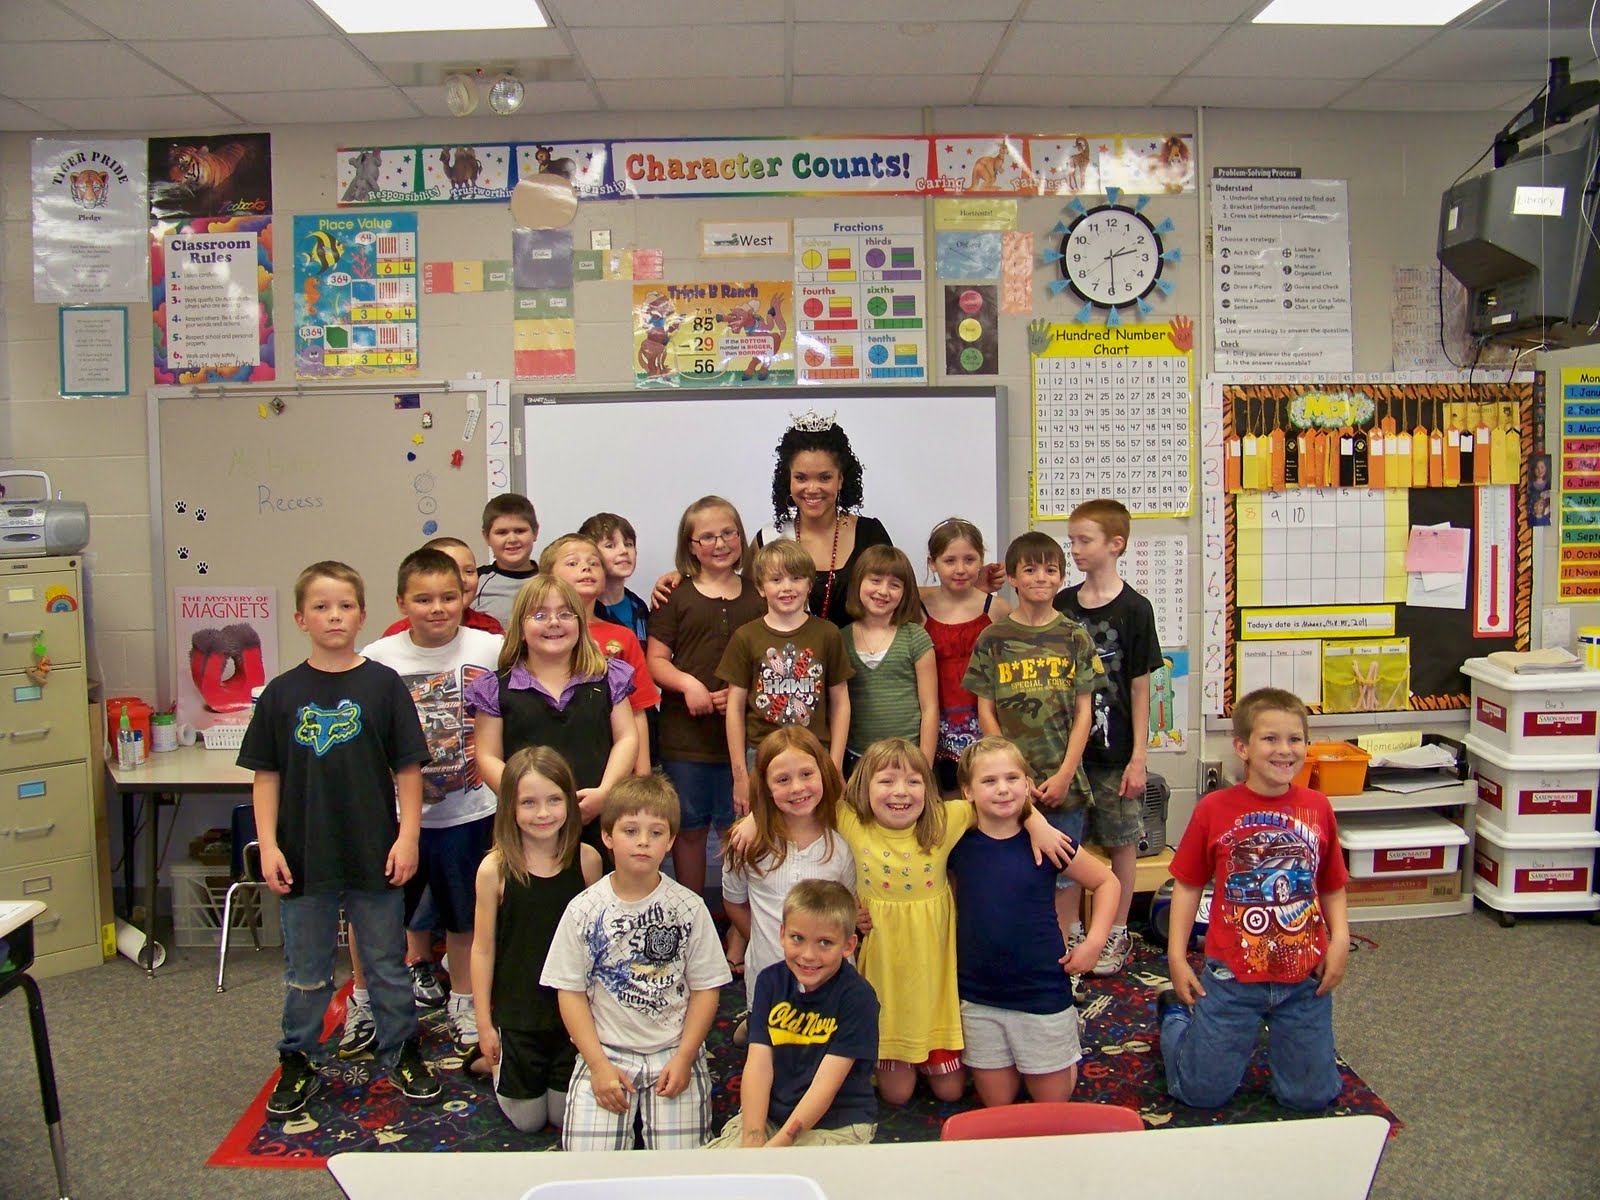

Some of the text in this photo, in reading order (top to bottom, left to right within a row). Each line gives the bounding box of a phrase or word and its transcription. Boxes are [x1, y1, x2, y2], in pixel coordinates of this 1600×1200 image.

[52, 151, 129, 185] TIGER PRIDE
[625, 152, 912, 181] Character Counts!
[1272, 168, 1297, 178] Process
[915, 175, 965, 191] Caring
[1215, 184, 1253, 192] Understand
[368, 185, 441, 201] Responsibility
[451, 186, 512, 198] Trustworthin
[319, 218, 393, 230] Place Value
[833, 222, 884, 232] Fractions
[1088, 224, 1130, 232] 11 1
[1105, 218, 1117, 227] 12
[1217, 224, 1232, 232] Plan
[360, 233, 372, 242] 64
[740, 235, 773, 246] West
[865, 237, 892, 246] thirds
[1075, 236, 1145, 244] 10 2
[171, 240, 251, 251] Classroom
[189, 252, 232, 264] Rules
[1073, 253, 1149, 262] 9 3
[331, 275, 348, 284] 364
[1078, 270, 1144, 278] 8 4
[667, 284, 758, 302] Triple B Ranch
[802, 286, 894, 295] fourths sixths
[1092, 283, 1133, 296] 7 6 5
[361, 309, 411, 319] 3 6 4
[693, 316, 714, 332] 85
[1219, 316, 1237, 325] Solve
[232, 333, 253, 341] personal
[300, 328, 322, 337] 1,364
[1056, 329, 1110, 341] Hundred
[1116, 329, 1166, 341] Number
[694, 337, 714, 352] 29
[868, 335, 897, 343] tenths
[1220, 340, 1240, 348] Check
[1093, 344, 1129, 355] Chart
[694, 359, 715, 374] 56
[1100, 392, 1110, 400] 25
[1162, 392, 1170, 400] 29
[1176, 392, 1186, 400] 30
[489, 421, 508, 446] 2
[1204, 421, 1223, 447] 2
[1054, 438, 1186, 448] 52 55 58 59 60
[1579, 460, 1598, 471] May
[488, 459, 508, 488] 3
[1146, 470, 1156, 478] 78
[1203, 458, 1221, 486] 3
[257, 485, 323, 515] Recess
[1578, 496, 1597, 506] July
[1271, 507, 1305, 523] 9 10
[182, 602, 270, 619] MAGNETS
[1247, 621, 1274, 630] Today's
[1275, 619, 1292, 628] date
[1295, 620, 1300, 628] is
[1011, 681, 1042, 690] SPECIAL
[1243, 812, 1290, 828] STREET
[768, 1001, 806, 1033] Old
